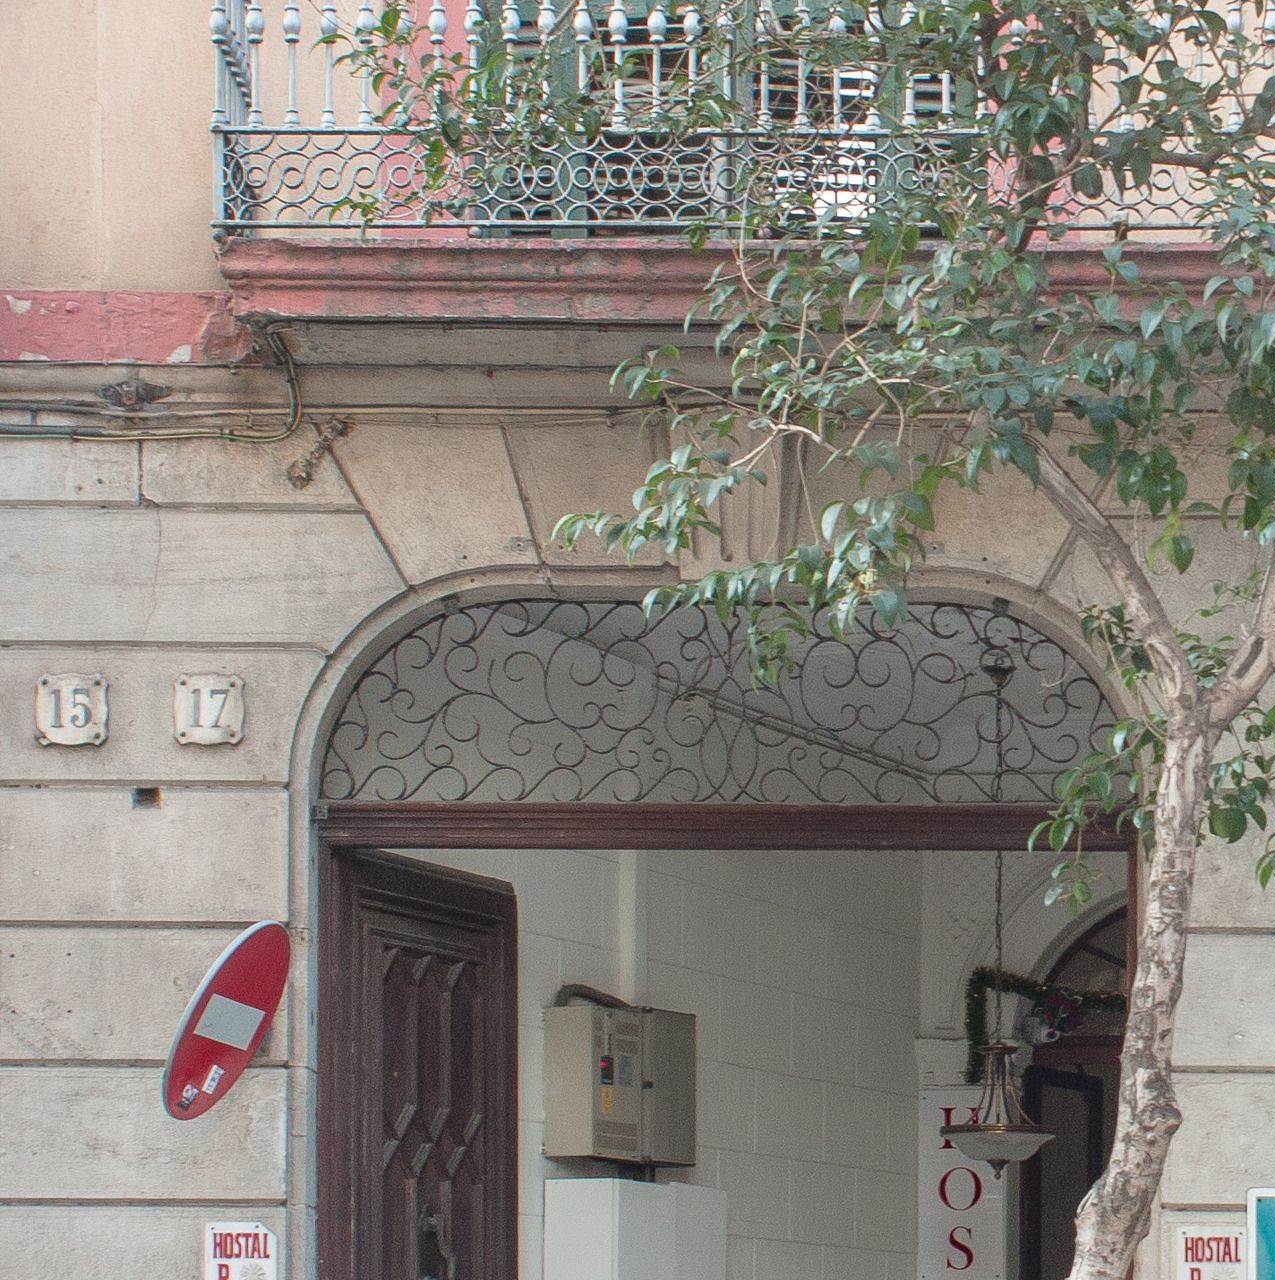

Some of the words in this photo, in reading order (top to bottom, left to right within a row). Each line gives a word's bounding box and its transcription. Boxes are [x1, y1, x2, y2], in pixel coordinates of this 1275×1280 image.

[50, 688, 92, 728] 15
[190, 688, 229, 728] 17
[212, 1232, 271, 1259] HOSTAL
[1184, 1236, 1241, 1263] HOSTAL
